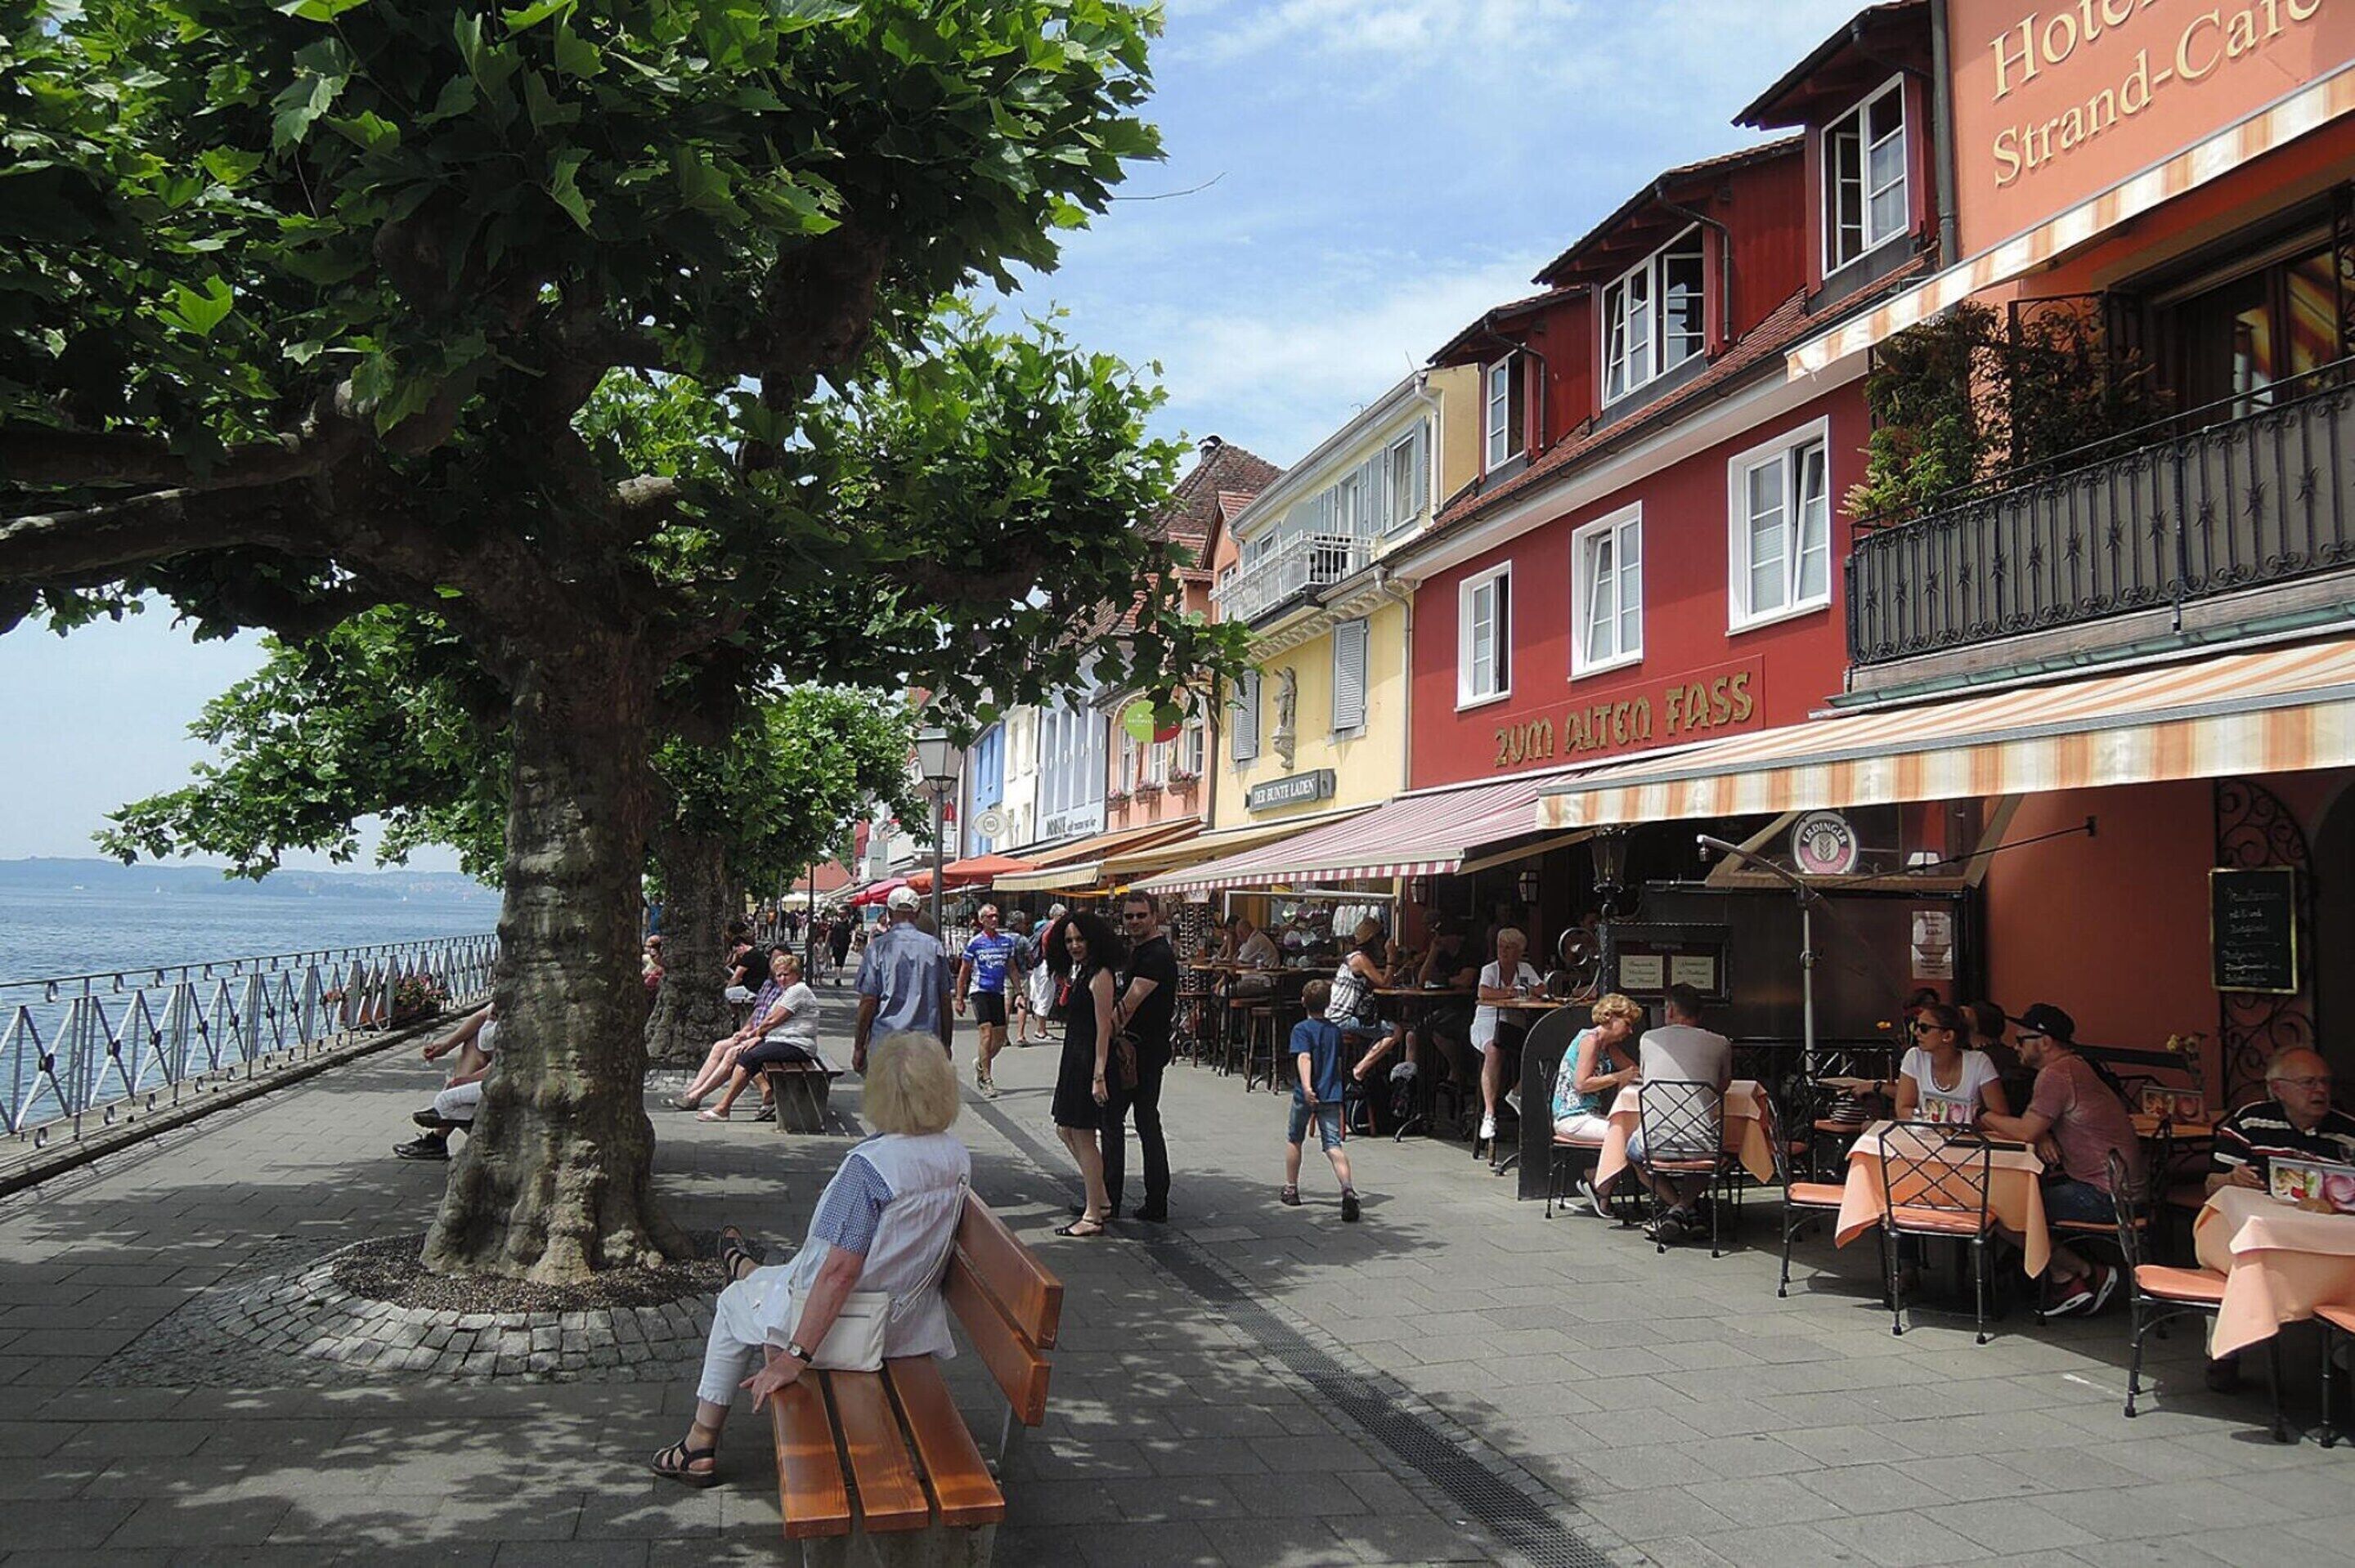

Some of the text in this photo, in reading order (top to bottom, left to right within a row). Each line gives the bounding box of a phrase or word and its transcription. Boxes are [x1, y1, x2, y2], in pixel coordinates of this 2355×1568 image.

[1989, 0, 2161, 101] Hote
[1496, 672, 1754, 767] ZUM ALTEN FASS
[1802, 822, 1848, 845] ERDINGER
